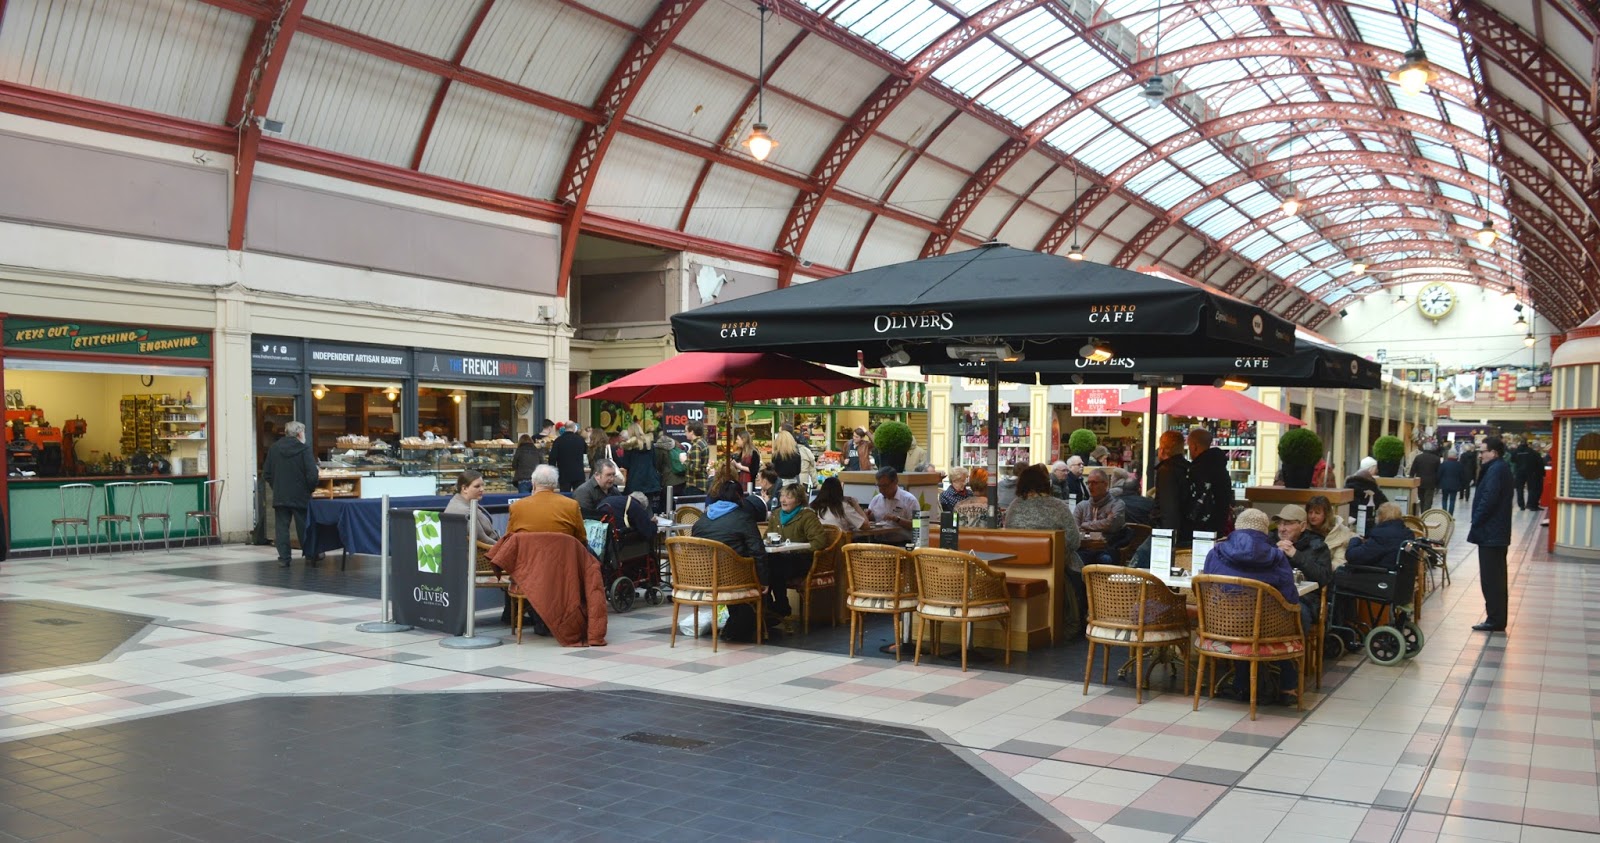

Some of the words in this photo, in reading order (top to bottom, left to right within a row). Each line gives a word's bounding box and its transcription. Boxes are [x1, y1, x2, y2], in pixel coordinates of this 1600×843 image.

[1091, 305, 1136, 313] BISTRO
[873, 312, 954, 333] OLIVERS
[1088, 311, 1135, 323] CAFE
[721, 321, 758, 329] BISTRO
[15, 328, 45, 341] KEYS
[47, 326, 70, 338] CUT
[74, 331, 138, 347] STITCHING
[720, 327, 757, 338] CAFE
[139, 336, 199, 352] ENGRAVING
[312, 351, 355, 362] INDEPENDENT
[354, 354, 380, 364] ARTISAN
[380, 356, 403, 365] BAKERY
[1234, 359, 1269, 368] CAFE
[462, 358, 499, 376] FRENCH
[268, 377, 277, 385] 27
[665, 414, 689, 425] rise
[687, 409, 703, 421] up
[1576, 449, 1600, 460] mm
[413, 586, 449, 607] OLIVERS
